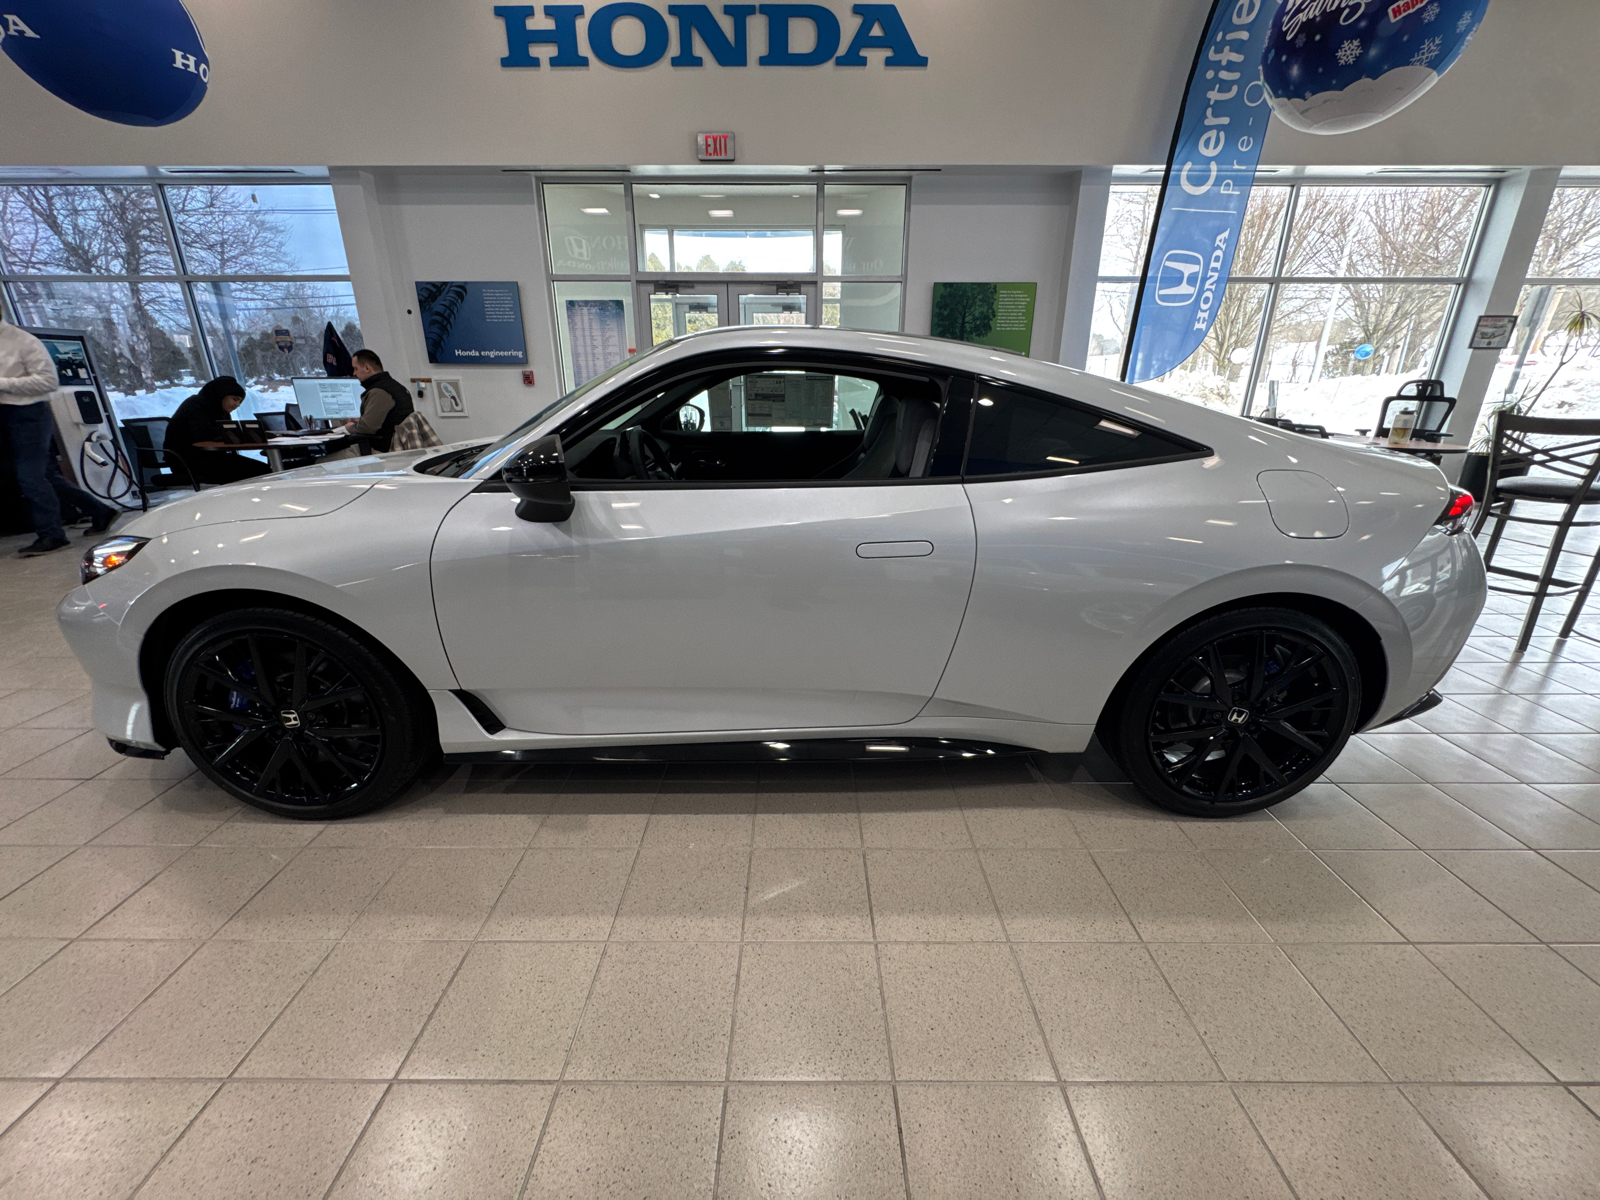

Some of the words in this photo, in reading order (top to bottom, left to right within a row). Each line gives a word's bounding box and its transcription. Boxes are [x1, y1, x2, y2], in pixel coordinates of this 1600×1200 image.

[494, 3, 928, 68] HONDA
[705, 134, 728, 156] EXIT
[1193, 227, 1231, 332] HONDA
[454, 349, 480, 357] Honda
[480, 349, 523, 358] engineering
